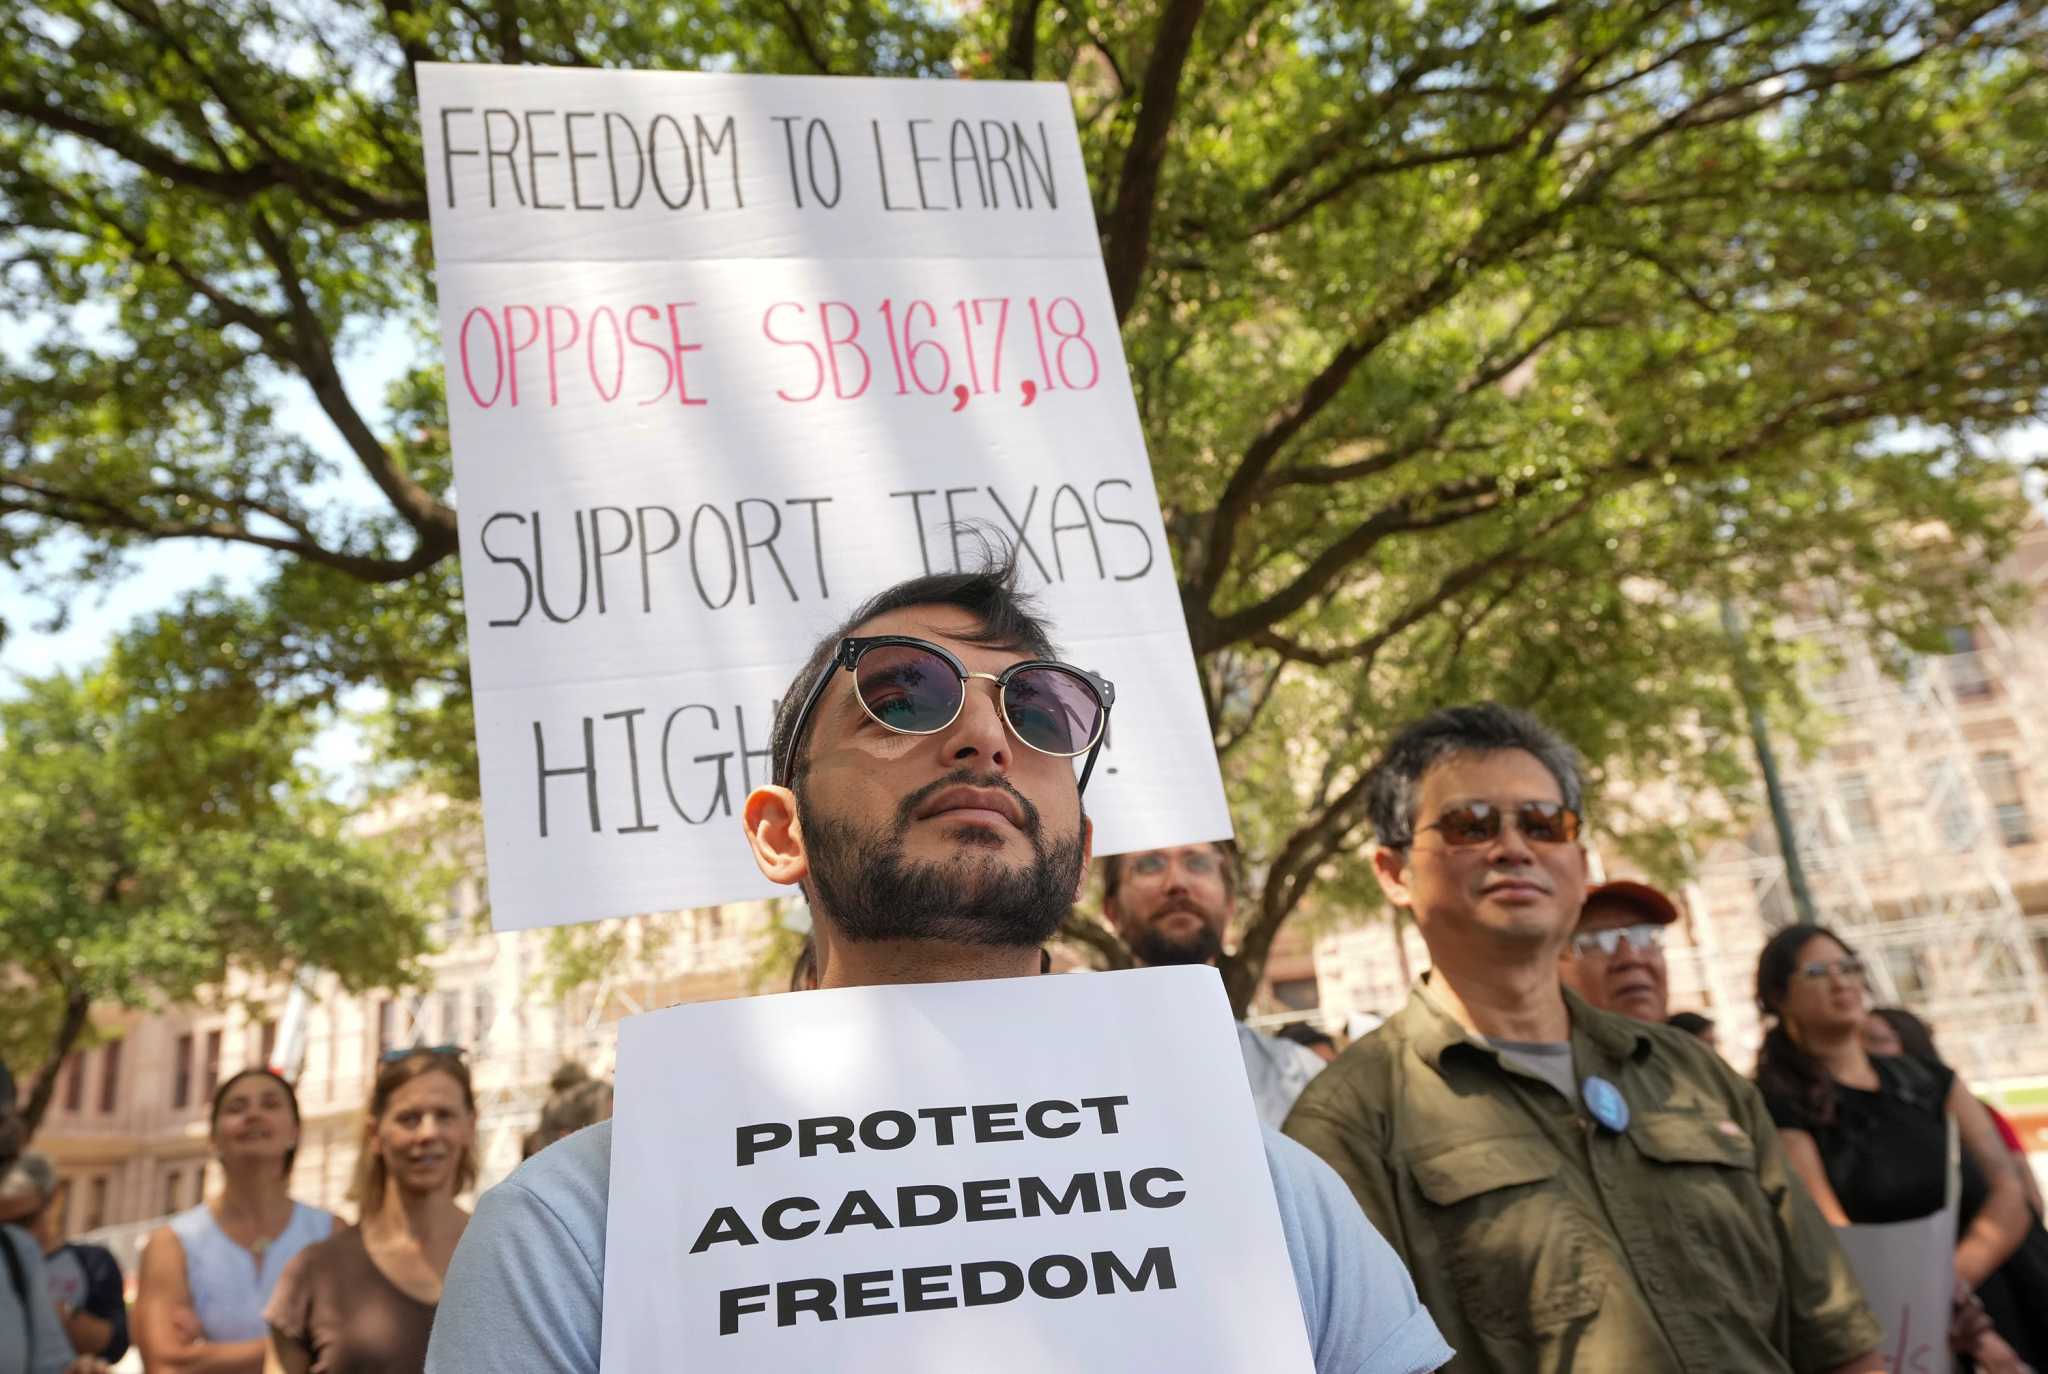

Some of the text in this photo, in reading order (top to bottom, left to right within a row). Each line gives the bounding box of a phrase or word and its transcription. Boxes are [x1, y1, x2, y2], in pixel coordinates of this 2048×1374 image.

[440, 107, 1058, 213] FREEDOM TO LEARN
[459, 301, 708, 410] OPPOSE
[480, 478, 1154, 628] SUPPORT TEXAS
[735, 1095, 1129, 1167] PROTECT
[688, 1167, 1187, 1255] ACADEMIC
[719, 1246, 1178, 1337] FREEDOM
